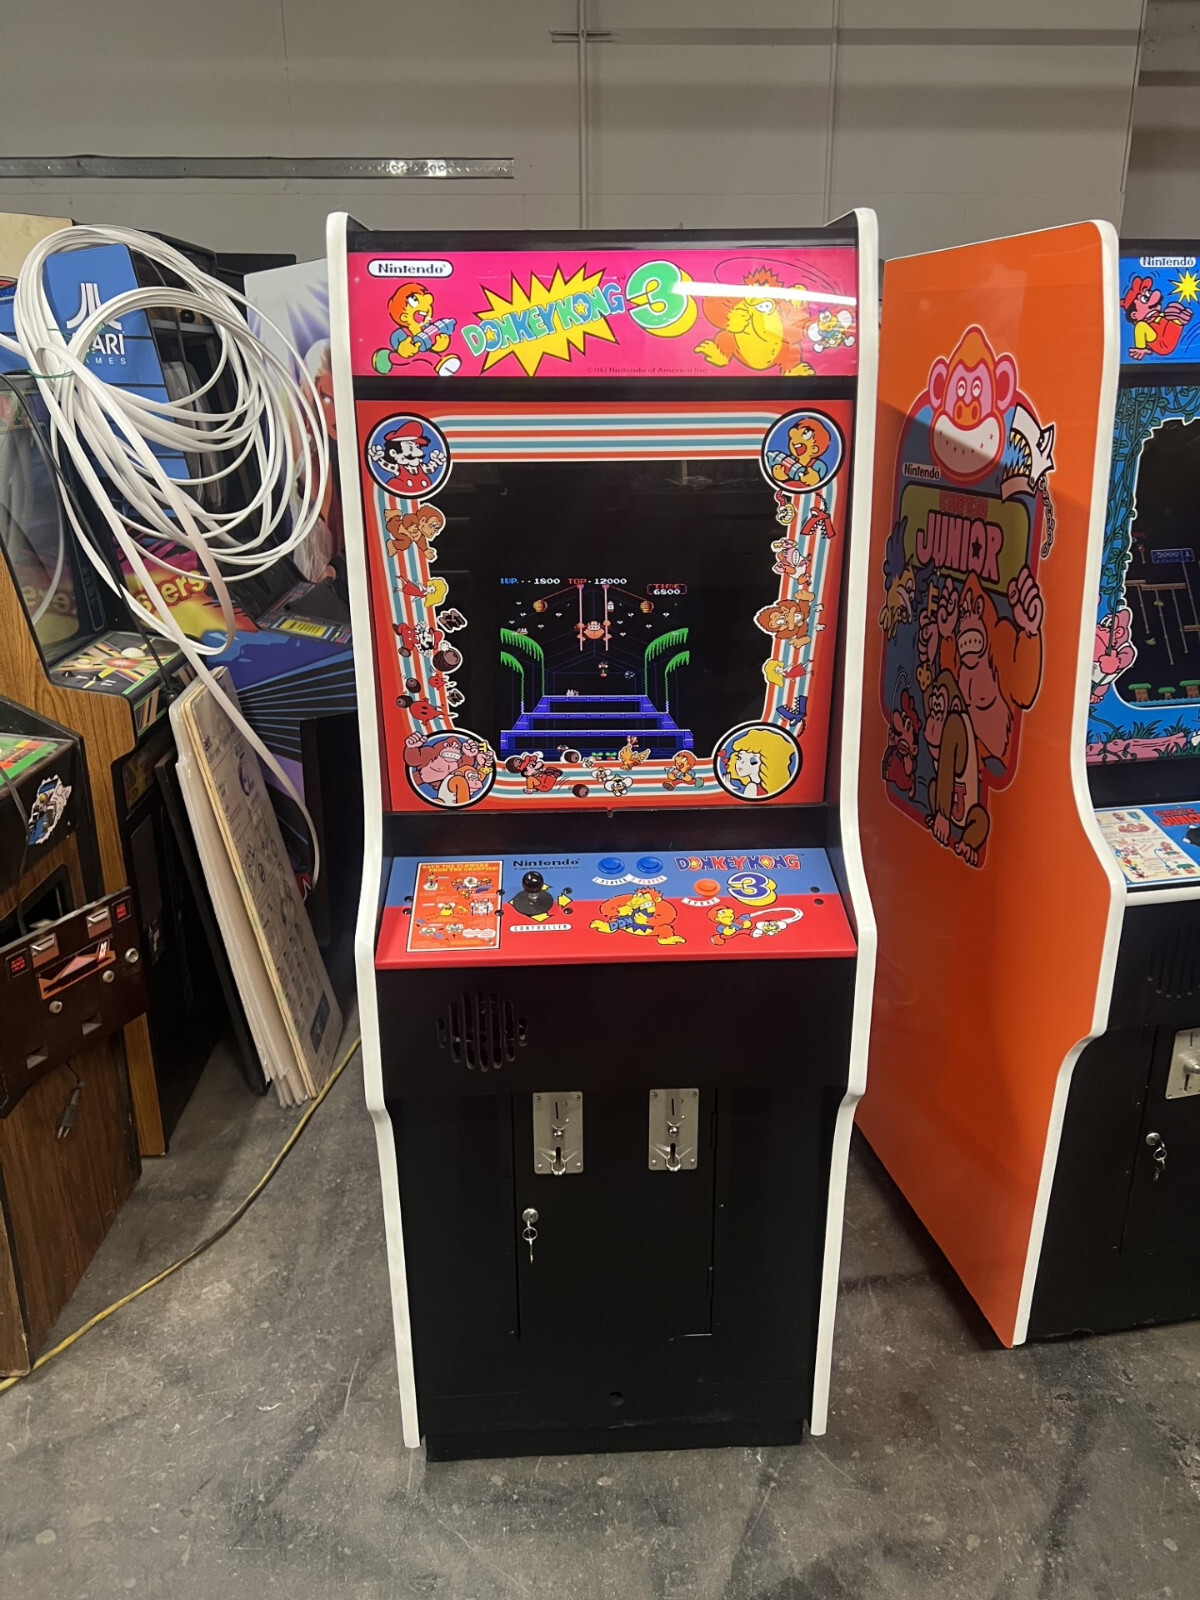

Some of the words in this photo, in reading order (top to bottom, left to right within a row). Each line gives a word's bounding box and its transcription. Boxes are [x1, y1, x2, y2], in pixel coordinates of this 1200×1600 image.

[378, 263, 443, 274] Nintendo
[1142, 257, 1194, 267] Nintendo
[626, 260, 694, 333] 3
[461, 302, 556, 357] DONKEY
[555, 283, 625, 330] KONG
[904, 463, 940, 479] Nintendo
[916, 509, 1003, 585] JUNIOR
[594, 577, 628, 585] 12000
[513, 858, 579, 867] Nintendo
[674, 855, 746, 871] DONKEY
[746, 854, 801, 871] KONG
[727, 872, 775, 904] 3
